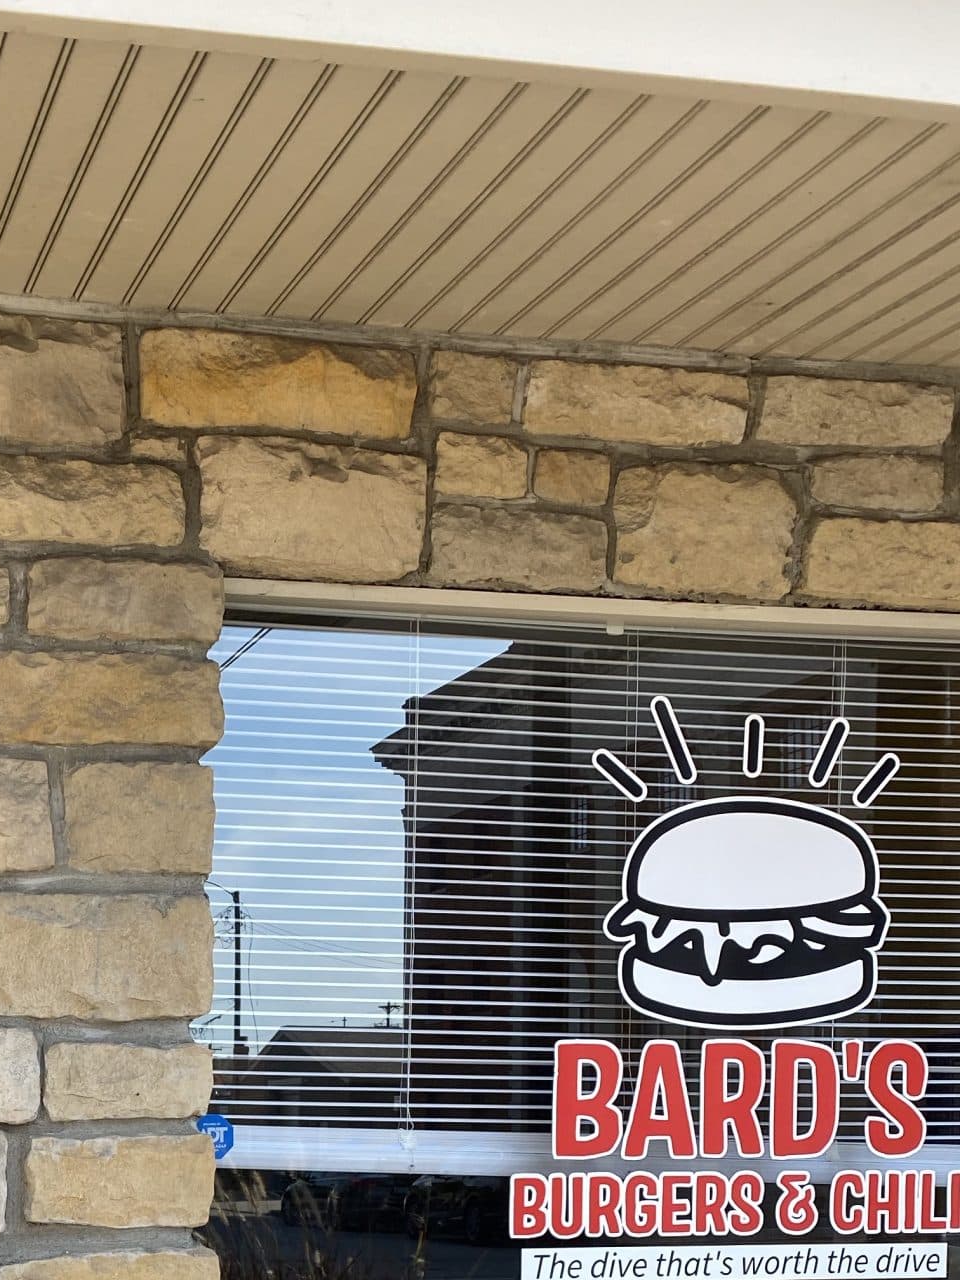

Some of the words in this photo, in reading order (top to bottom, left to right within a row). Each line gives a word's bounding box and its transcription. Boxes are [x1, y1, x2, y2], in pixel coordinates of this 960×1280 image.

[552, 1038, 929, 1160] BARD'S
[509, 1171, 763, 1239] BURGERS
[775, 1170, 819, 1236] &
[829, 1170, 960, 1237] CHILI
[534, 1253, 582, 1280] The
[590, 1252, 648, 1279] dive
[656, 1250, 734, 1277] that's
[741, 1248, 819, 1275] worth
[824, 1247, 869, 1274] the
[876, 1246, 940, 1274] drive
